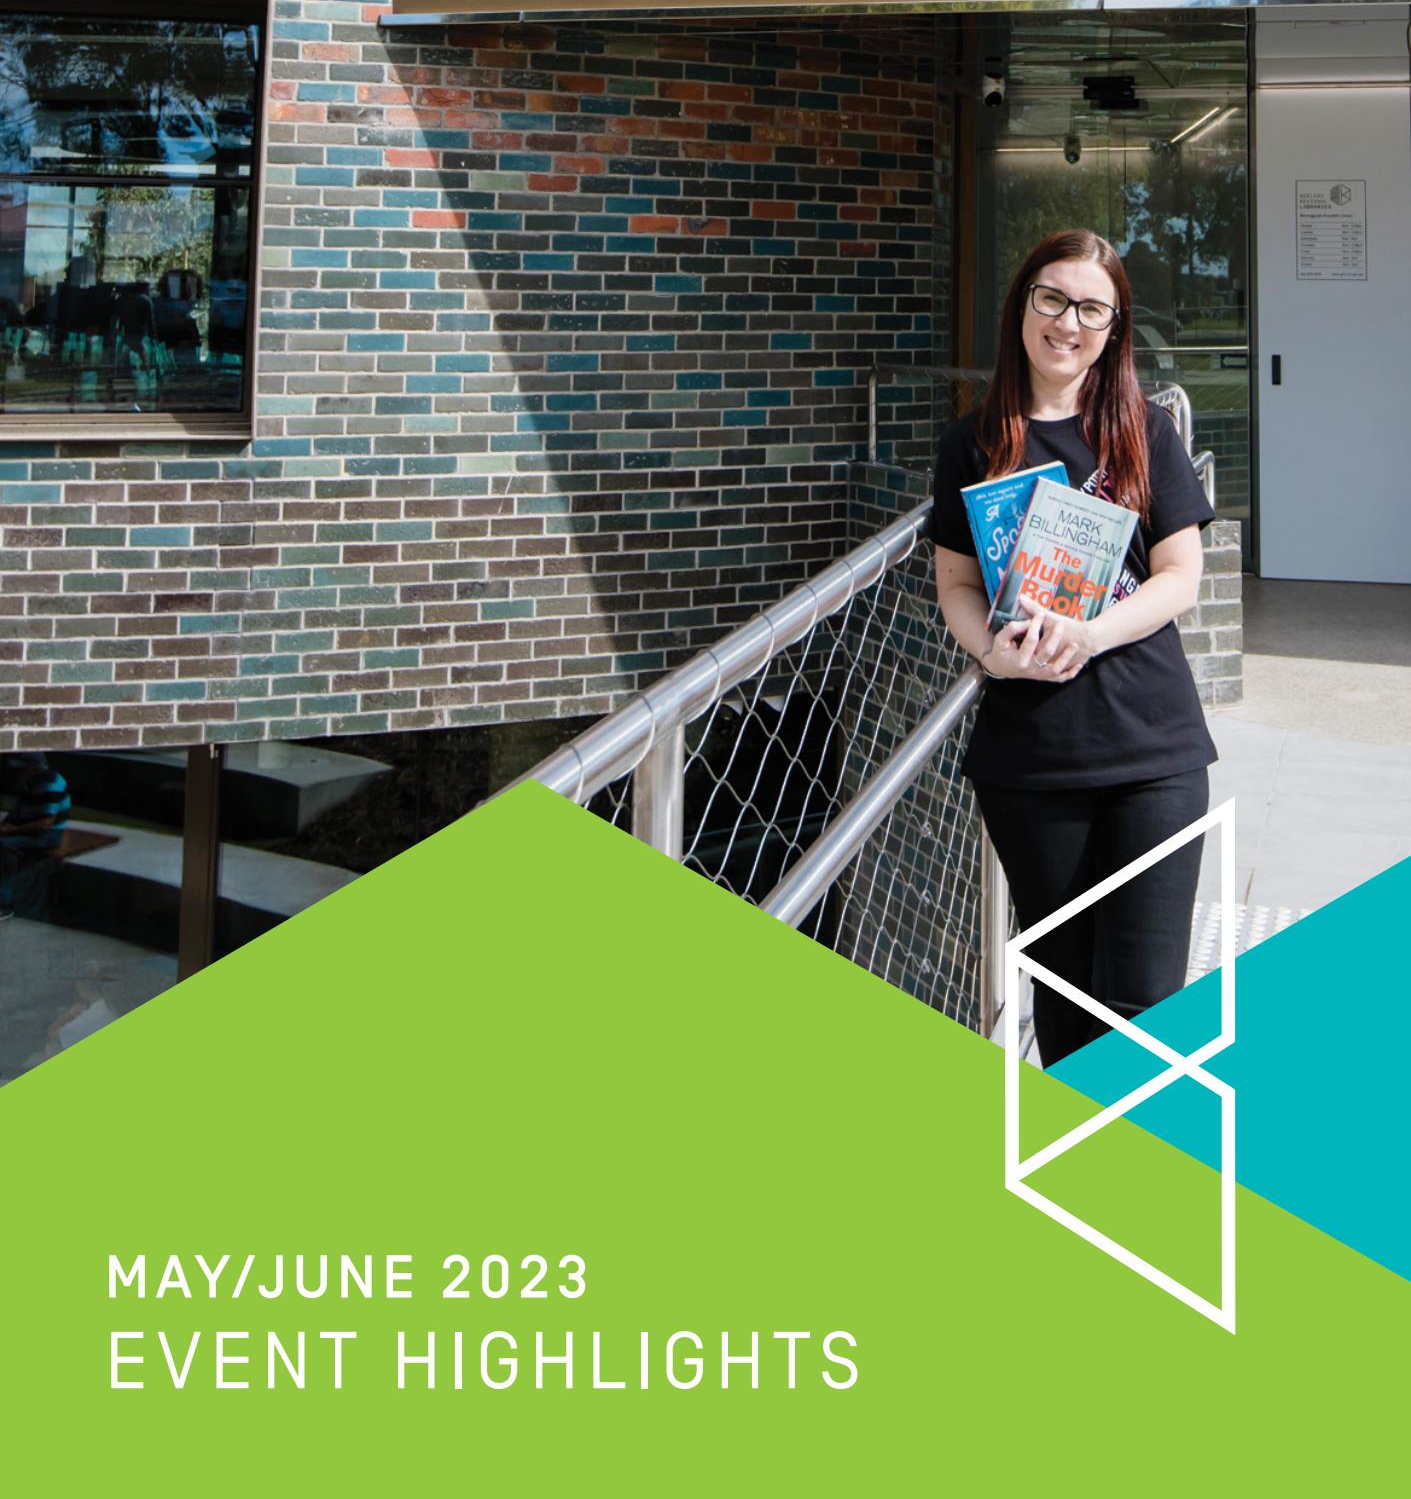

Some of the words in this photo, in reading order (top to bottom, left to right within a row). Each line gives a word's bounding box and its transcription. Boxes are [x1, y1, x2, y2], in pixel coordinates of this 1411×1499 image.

[1029, 514, 1123, 557] BILLINGHAM
[1057, 509, 1104, 536] MARK
[1014, 550, 1109, 601] Murder
[1053, 546, 1082, 569] The
[1020, 578, 1086, 622] Book
